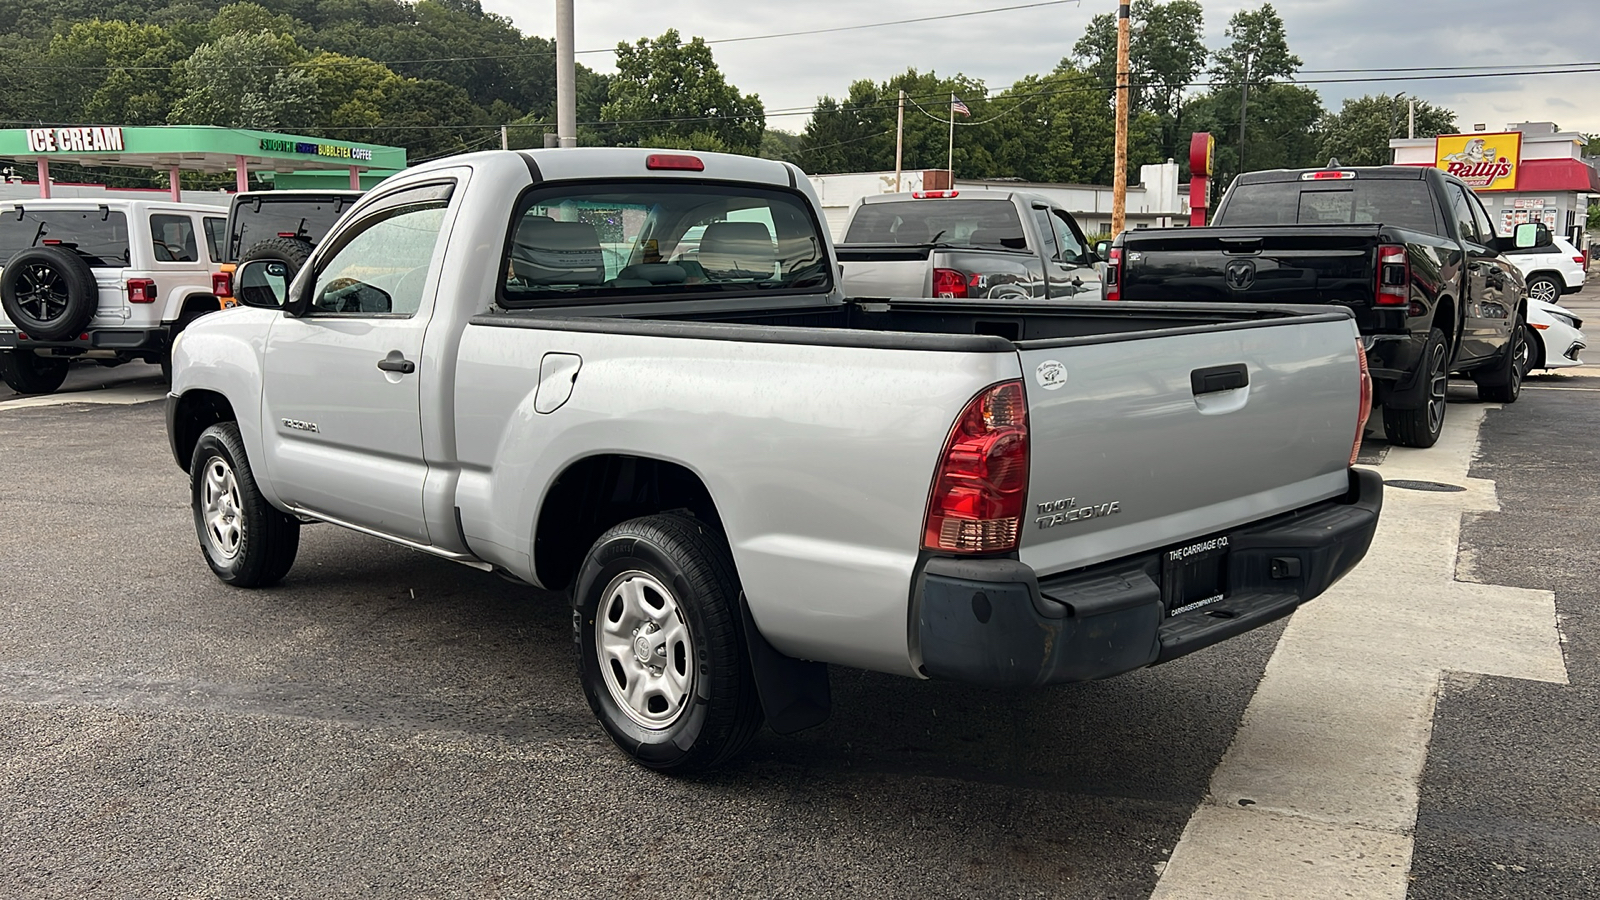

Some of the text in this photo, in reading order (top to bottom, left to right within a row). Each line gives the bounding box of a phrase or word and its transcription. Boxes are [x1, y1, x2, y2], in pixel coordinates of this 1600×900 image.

[26, 127, 124, 151] ICE CREAM
[351, 147, 372, 160] COFFEE
[1447, 157, 1512, 186] Rally's
[281, 417, 320, 433] TACOMA
[1034, 501, 1121, 529] TACOMA
[1037, 497, 1075, 514] TOYOTA
[1169, 536, 1229, 560] THE CARRIAGE CO.
[1170, 594, 1224, 617] CARRIAGECOMPANY.COM
